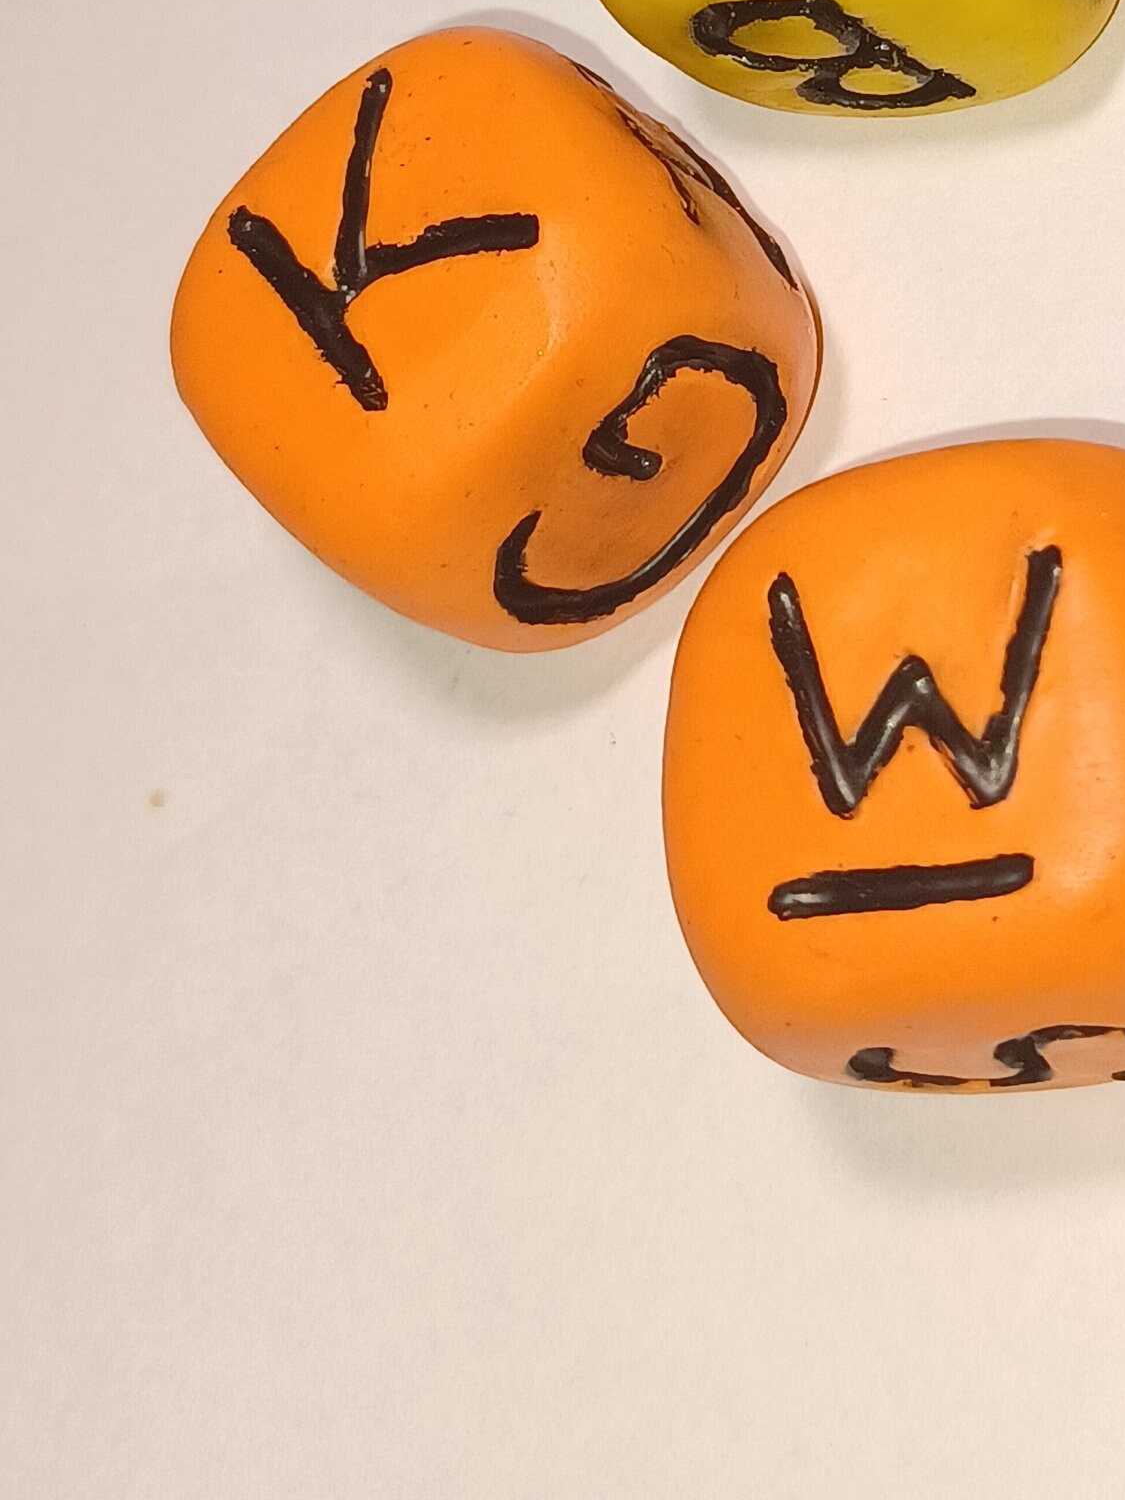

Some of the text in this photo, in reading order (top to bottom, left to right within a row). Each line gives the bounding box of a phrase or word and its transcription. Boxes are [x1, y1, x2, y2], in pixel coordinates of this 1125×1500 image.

[227, 67, 540, 411] K
[493, 334, 788, 626] G
[767, 544, 1062, 820] W
